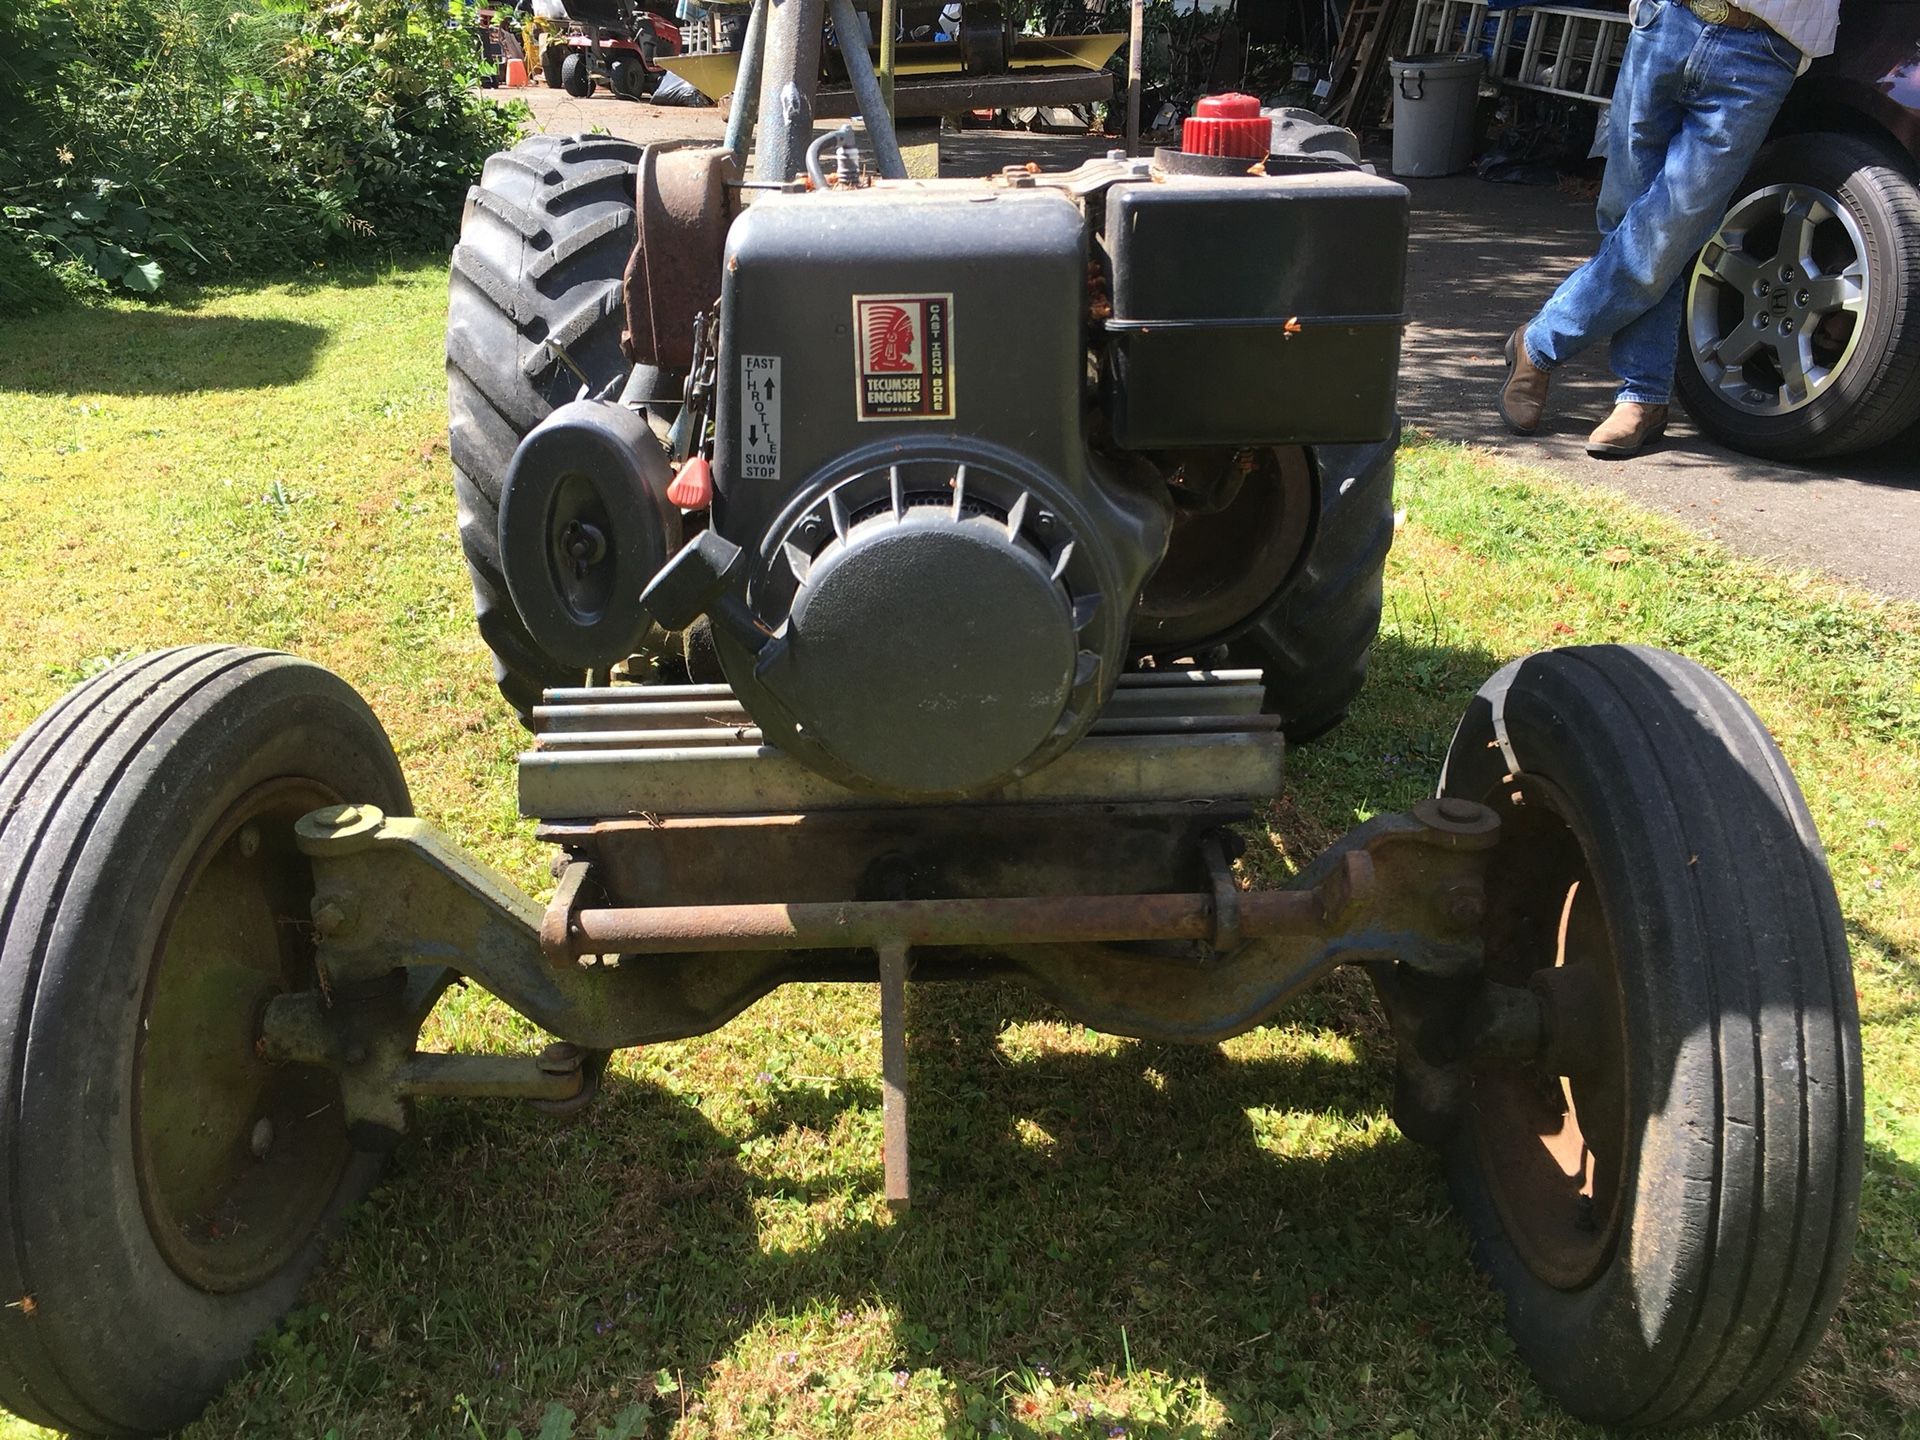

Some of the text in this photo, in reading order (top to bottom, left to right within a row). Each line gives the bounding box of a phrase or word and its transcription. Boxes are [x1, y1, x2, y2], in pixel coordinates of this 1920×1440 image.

[746, 357, 775, 369] FAST
[930, 305, 943, 411] CAST IRON BORE
[867, 378, 921, 391] TECUMSEH
[867, 391, 921, 404] ENGINES
[745, 369, 777, 454] THROTTLE
[745, 454, 776, 465] SLOW
[746, 467, 775, 478] STOP
